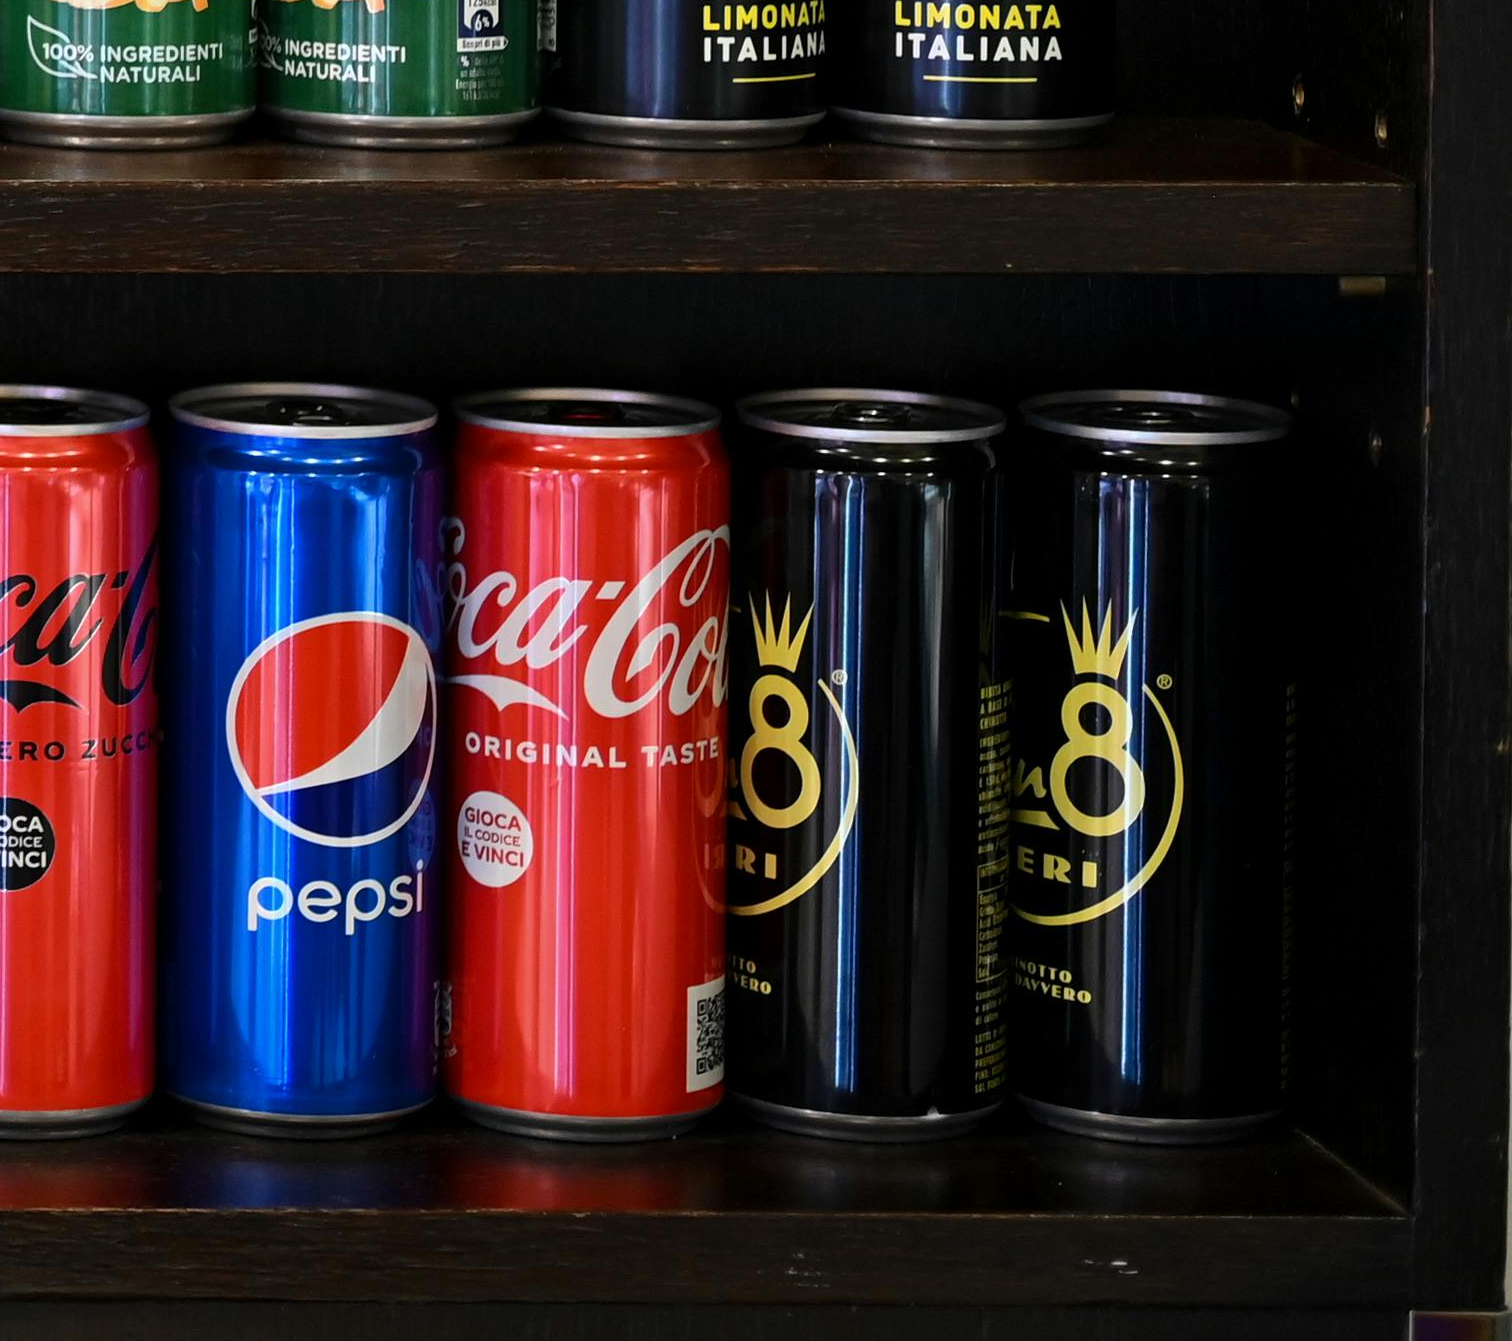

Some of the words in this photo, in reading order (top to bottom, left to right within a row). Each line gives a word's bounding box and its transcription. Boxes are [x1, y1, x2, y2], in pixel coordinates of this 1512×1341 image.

[464, 732, 627, 770] ORIGINAL
[642, 738, 721, 768] TASTE
[248, 860, 423, 936] pepsi
